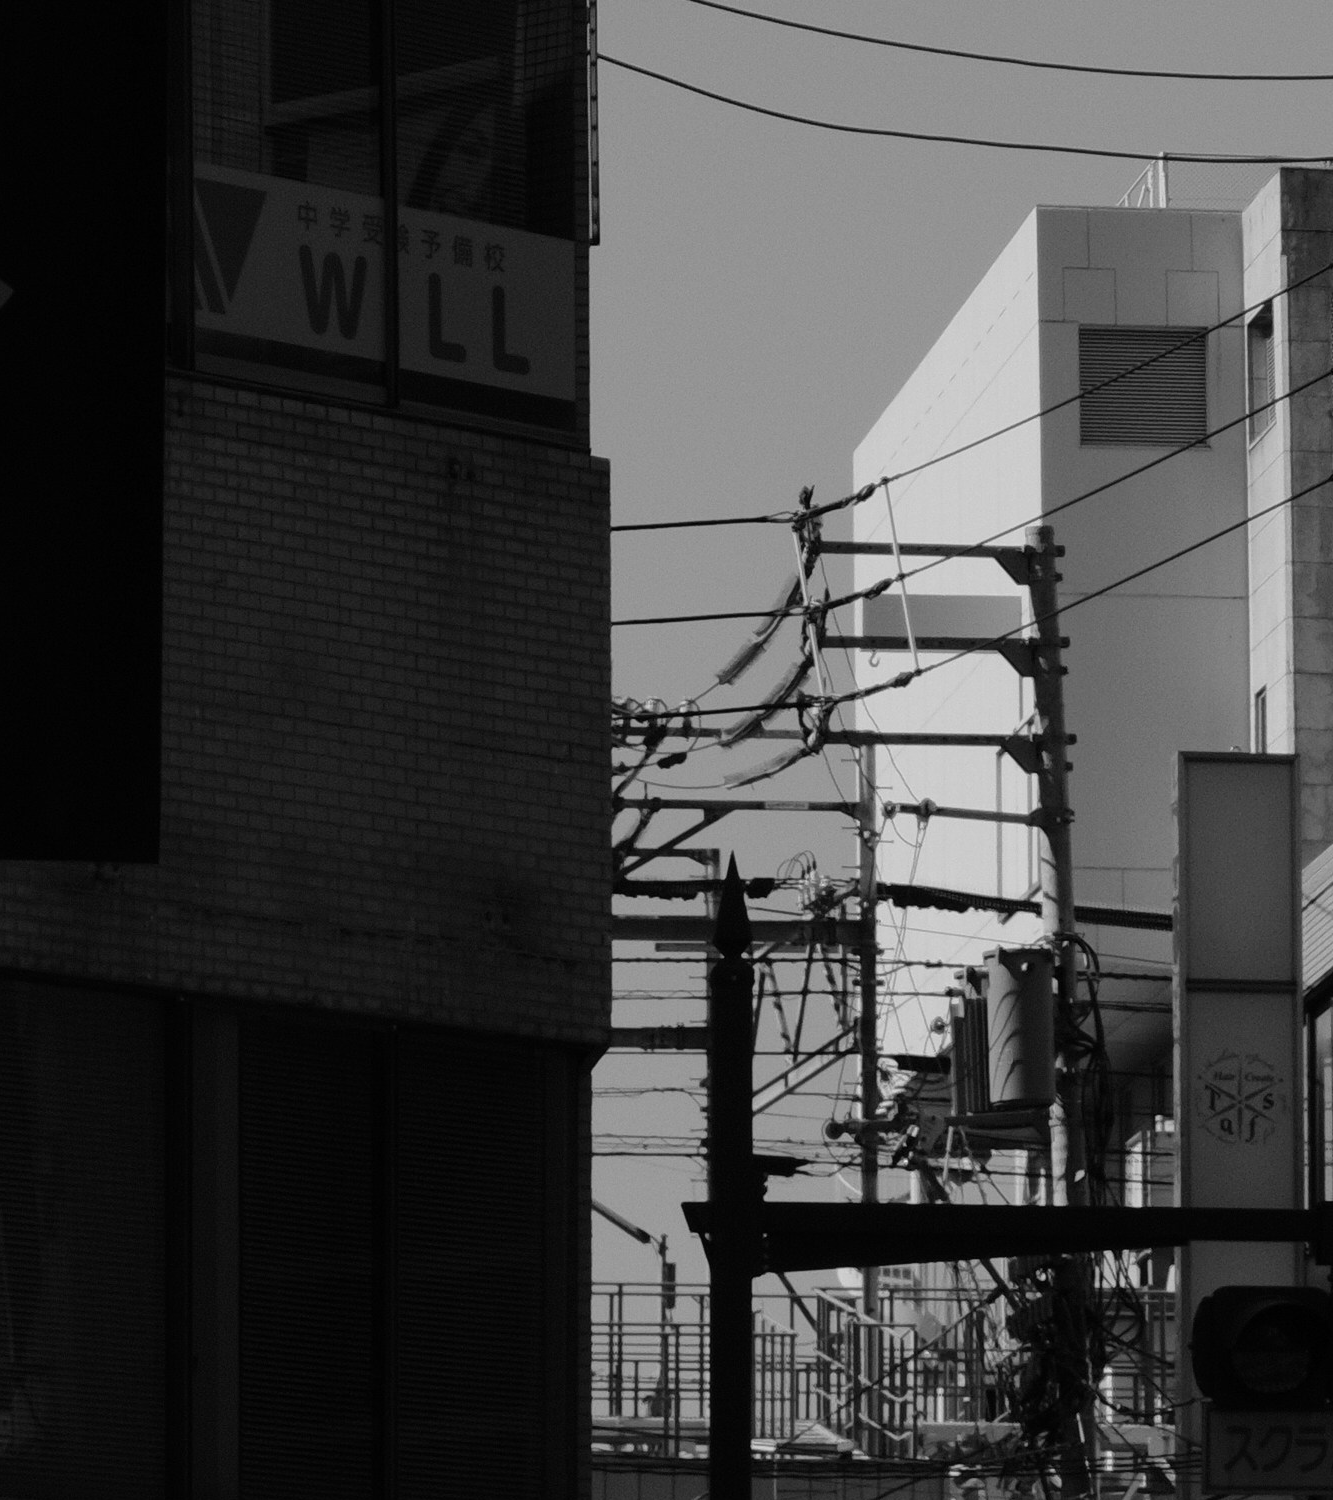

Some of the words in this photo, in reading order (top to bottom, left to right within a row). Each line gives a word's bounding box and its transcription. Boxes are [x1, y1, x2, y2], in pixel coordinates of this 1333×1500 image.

[298, 244, 530, 375] WLL
[1223, 1424, 1333, 1474] スクラ
